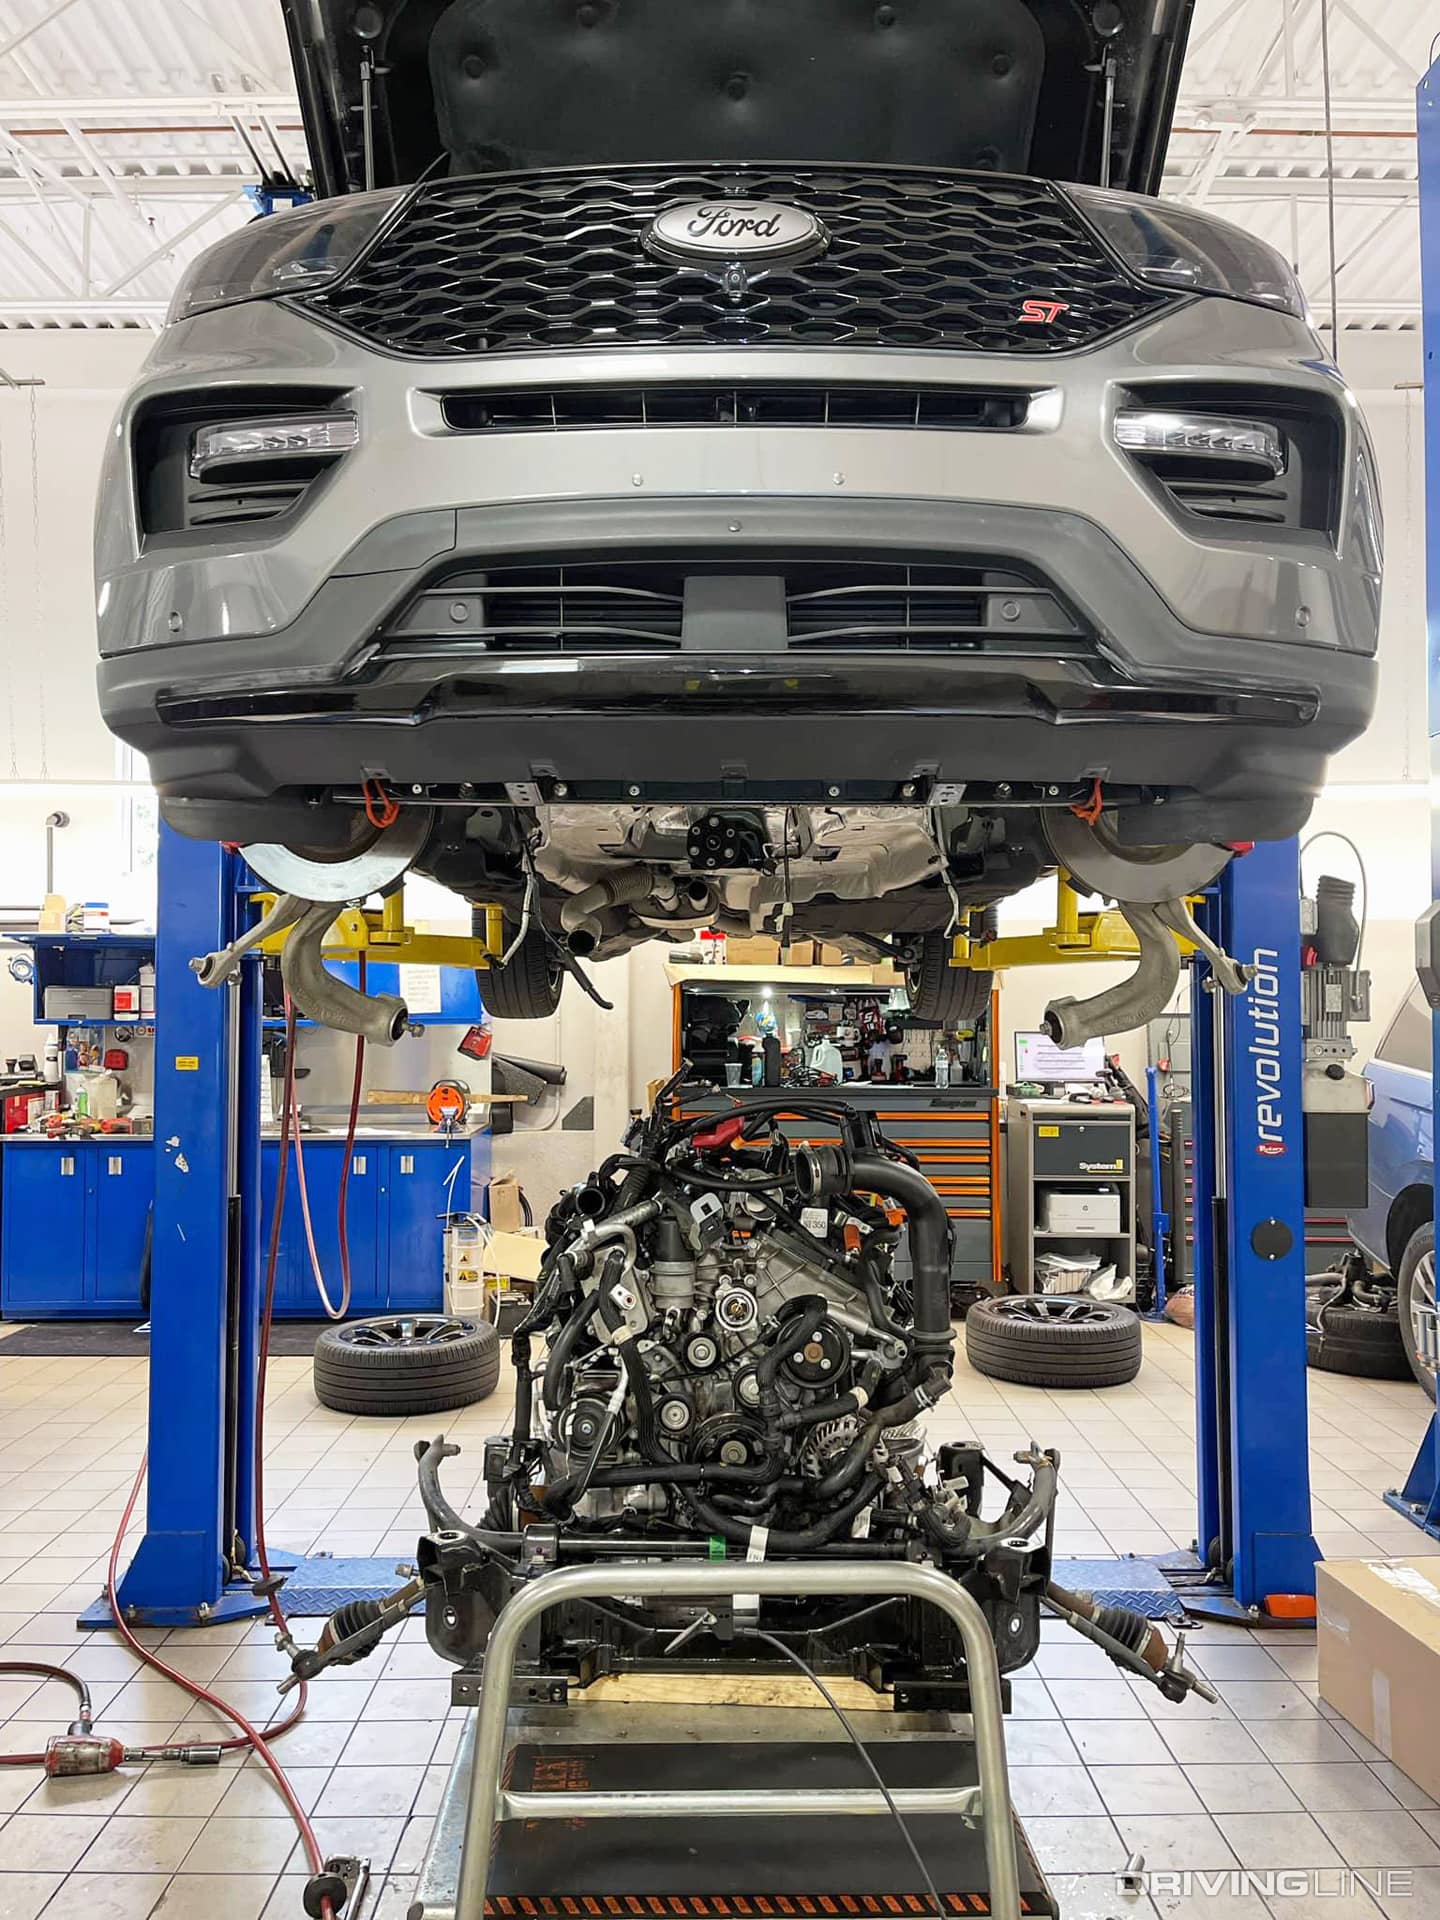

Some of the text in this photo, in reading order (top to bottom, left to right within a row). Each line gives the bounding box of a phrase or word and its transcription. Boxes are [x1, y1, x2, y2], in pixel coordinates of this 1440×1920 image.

[687, 204, 783, 238] Ford
[1018, 300, 1069, 323] ST
[1248, 948, 1283, 1142] revolution
